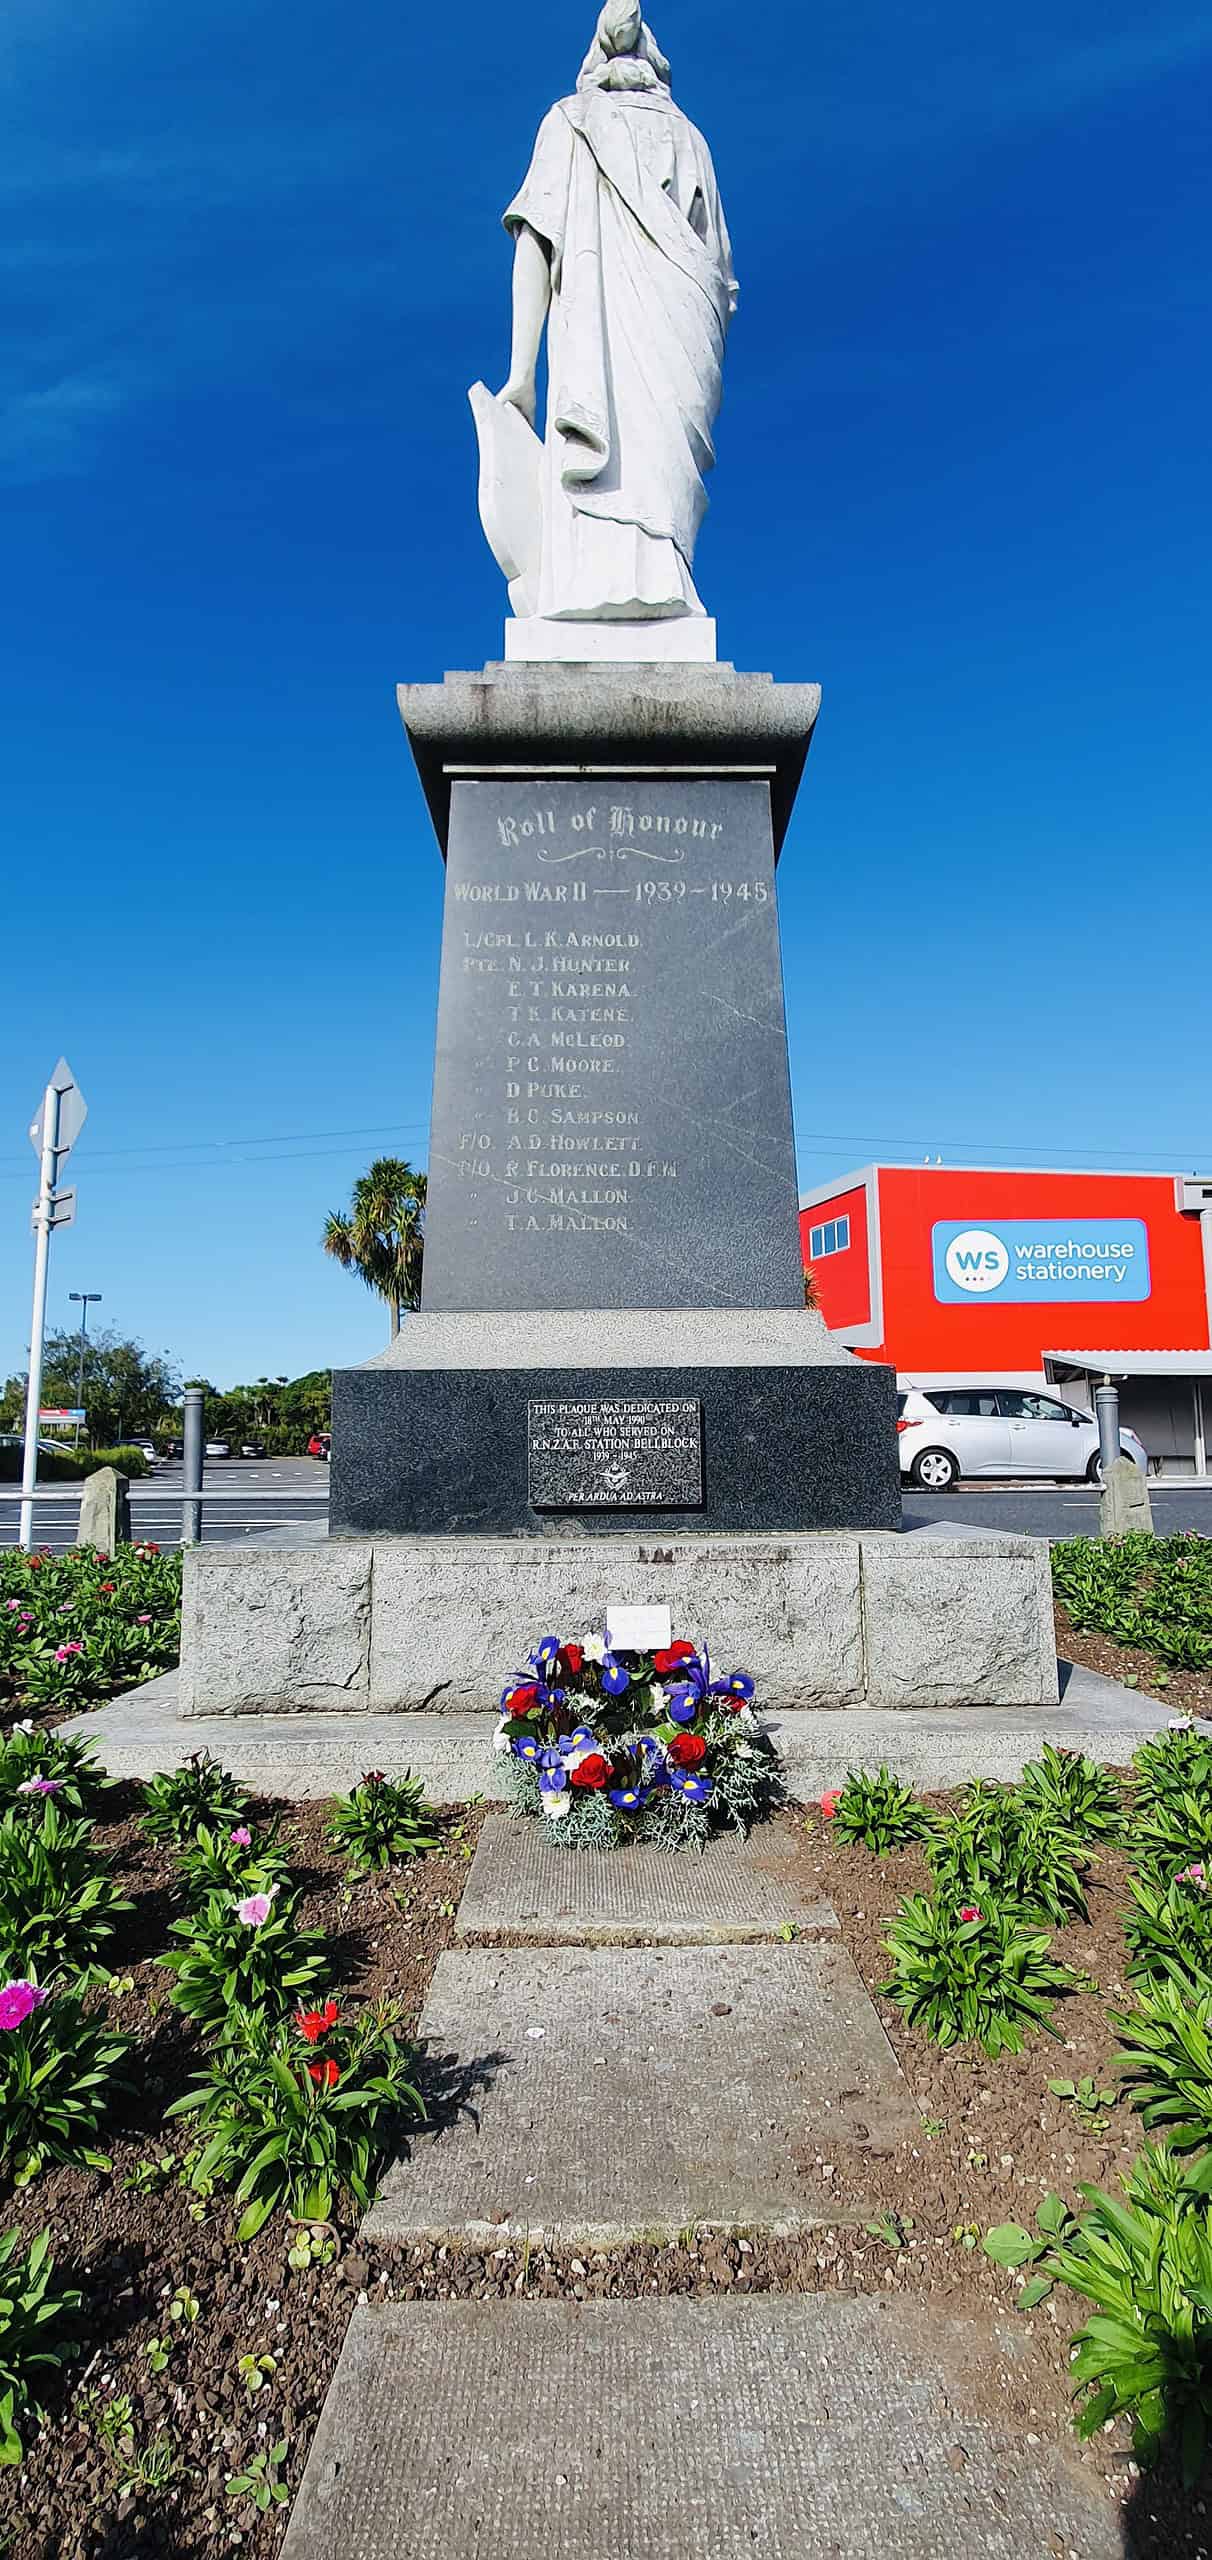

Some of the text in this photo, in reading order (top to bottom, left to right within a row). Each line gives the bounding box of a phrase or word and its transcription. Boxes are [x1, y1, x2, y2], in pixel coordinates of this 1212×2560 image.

[497, 806, 723, 847] Roll of Honour
[454, 882, 519, 902] WORLD
[523, 881, 567, 902] WAR
[956, 1240, 1134, 1270] WS warehouse
[1016, 1262, 1127, 1282] stationery
[534, 1403, 697, 1415] THIS PLAQUE WAS DEDICATED ON
[604, 1415, 625, 1425] MAY
[555, 1426, 675, 1438] TO ALL WHO SERVED ON
[584, 1438, 630, 1450] STATION
[593, 1451, 610, 1461] 1939
[567, 1491, 663, 1501] PER ARDUA AD ASTRA
